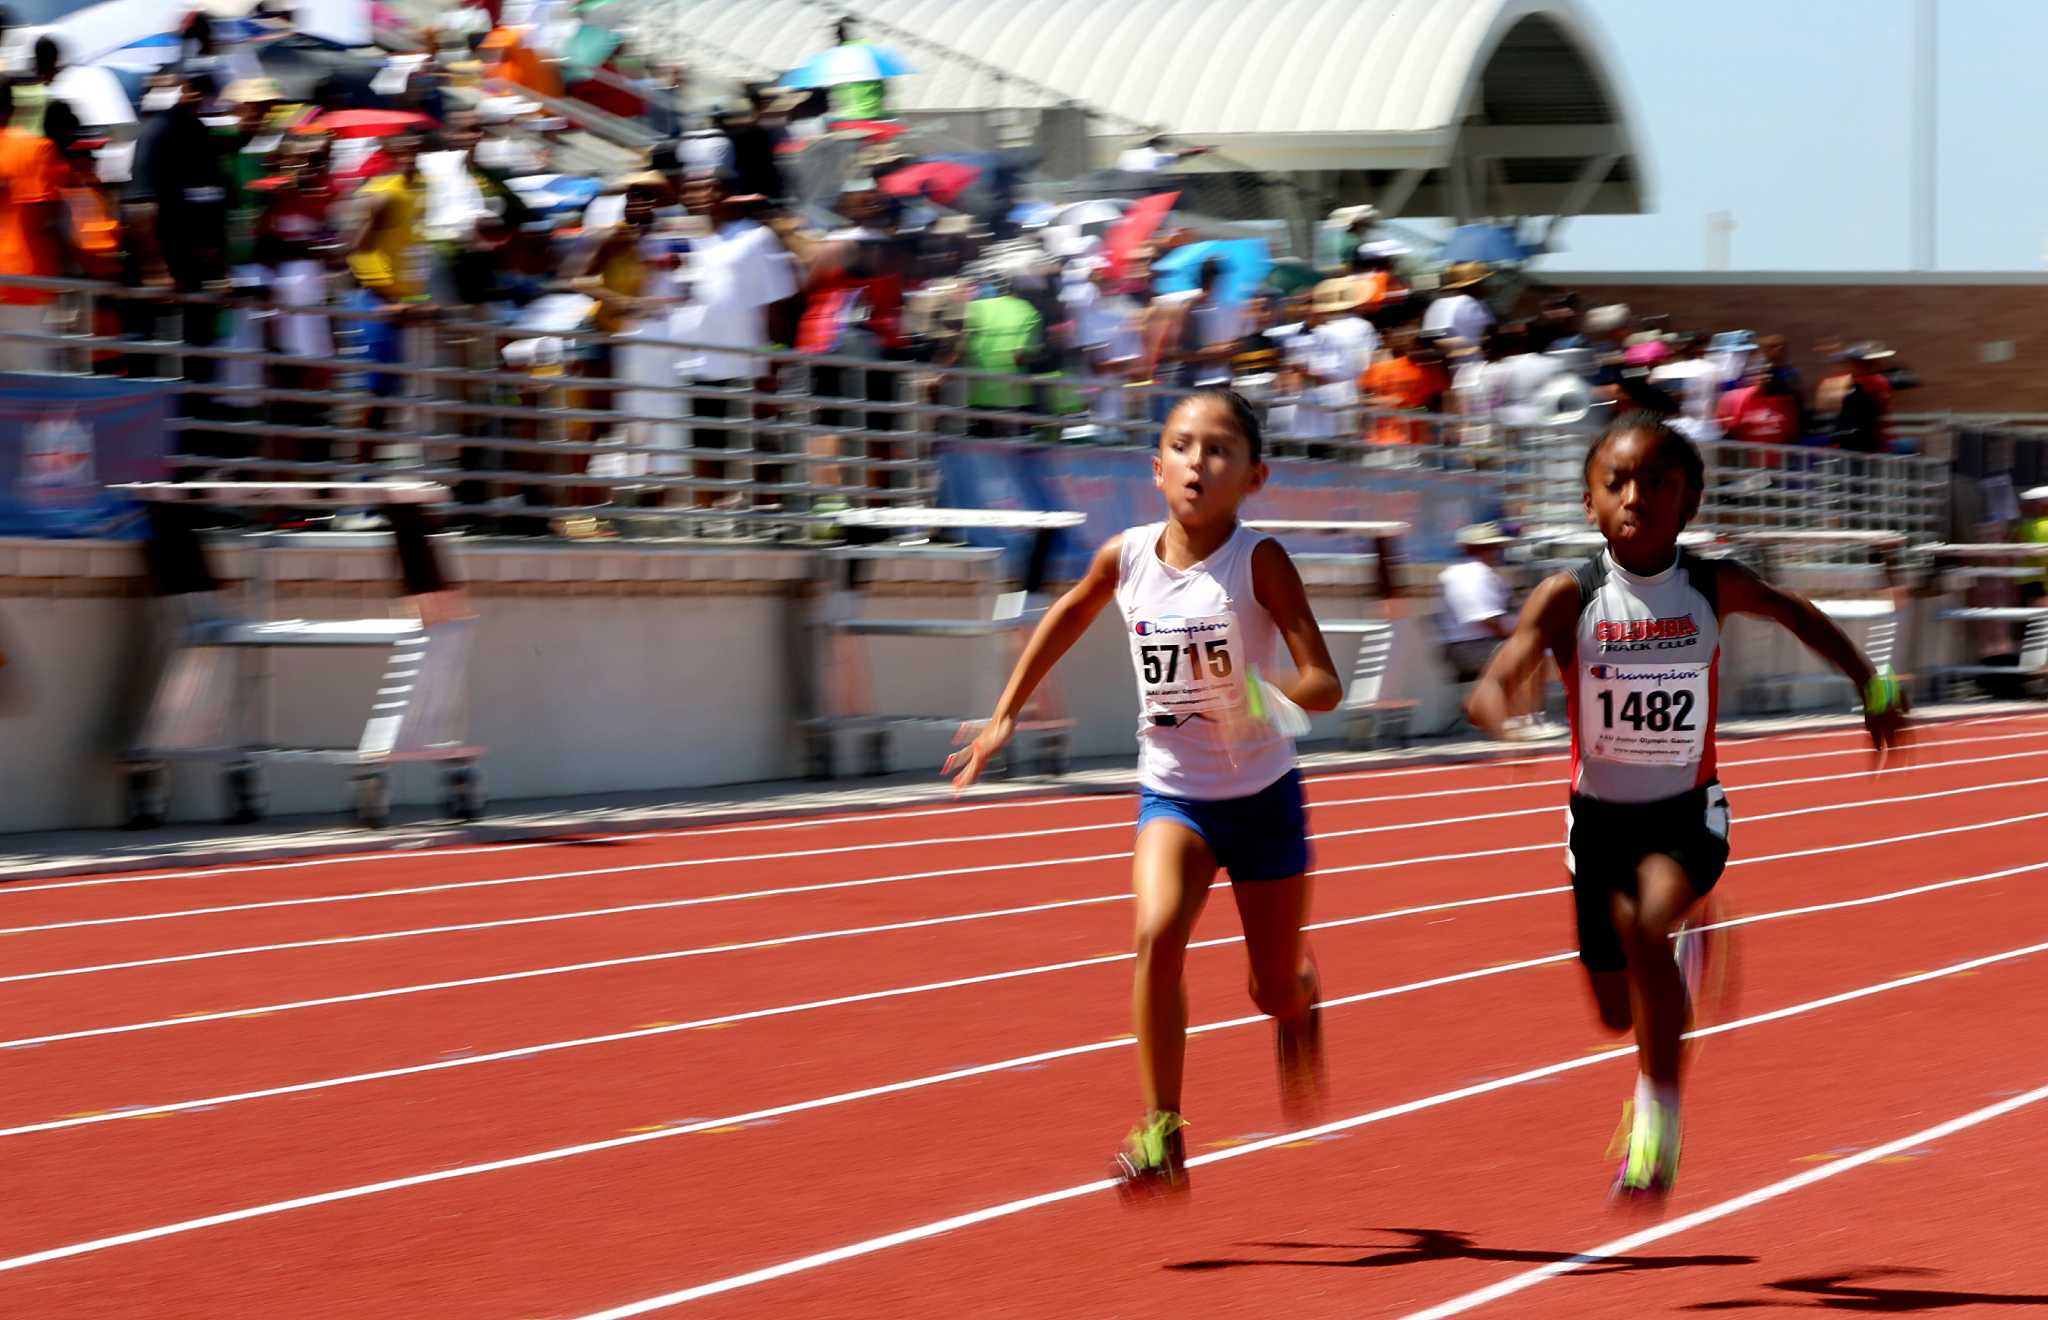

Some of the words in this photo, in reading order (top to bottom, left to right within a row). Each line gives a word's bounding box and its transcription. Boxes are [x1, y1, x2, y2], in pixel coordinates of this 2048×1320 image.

[1135, 621, 1230, 639] Champion
[1656, 638, 1697, 650] CLUB
[1140, 639, 1233, 685] 5715
[1590, 664, 1701, 687] Champion
[1597, 689, 1696, 733] 1482
